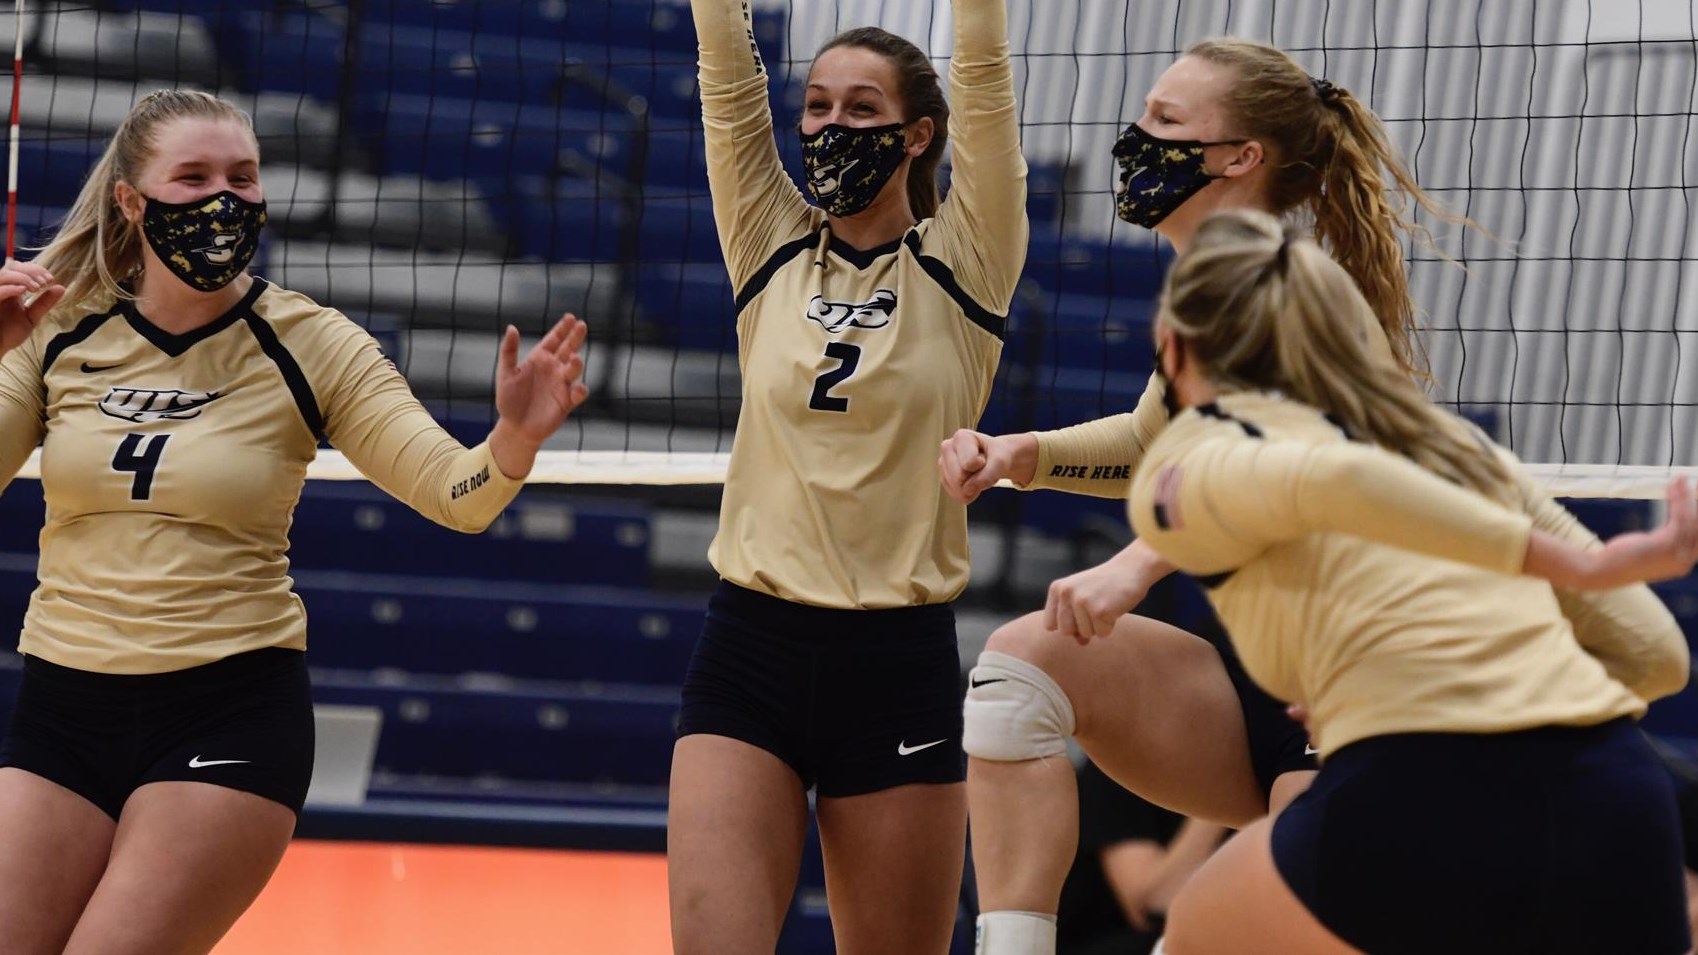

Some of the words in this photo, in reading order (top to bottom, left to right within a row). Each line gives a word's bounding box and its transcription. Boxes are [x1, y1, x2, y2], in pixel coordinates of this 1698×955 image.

[808, 341, 862, 413] 2
[98, 387, 224, 423] UIS
[111, 432, 172, 501] 4
[1049, 464, 1089, 479] RISE
[1090, 464, 1131, 480] HERE
[451, 479, 469, 500] RISE
